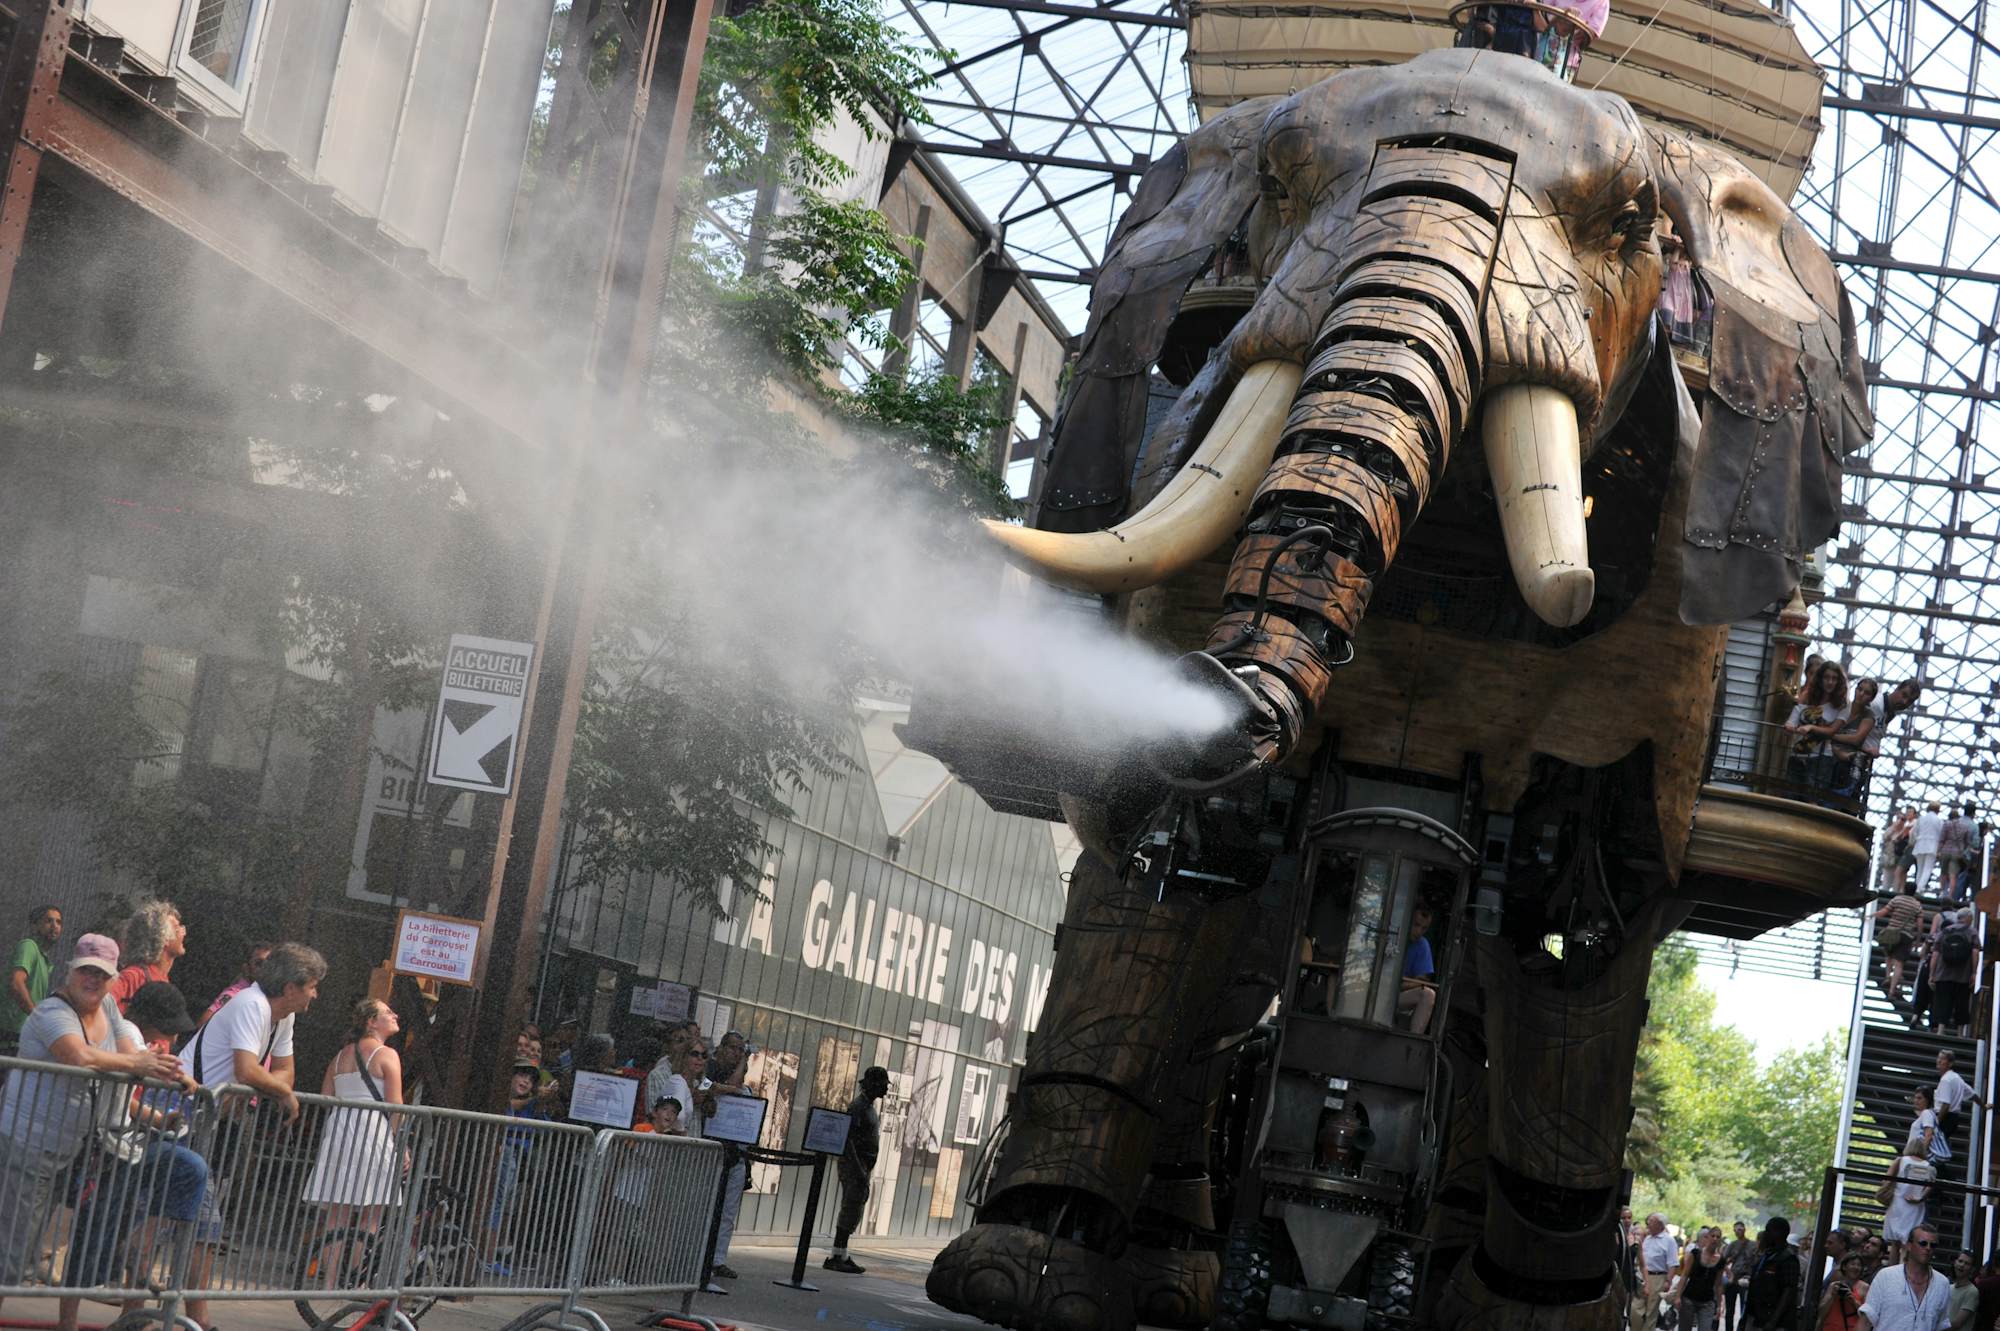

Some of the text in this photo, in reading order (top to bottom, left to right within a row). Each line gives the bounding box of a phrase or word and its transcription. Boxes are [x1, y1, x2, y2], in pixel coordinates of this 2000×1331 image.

[451, 650, 523, 675] ACCUEIL
[448, 672, 522, 695] BILLETTERIE
[409, 921, 470, 940] La billetterie
[406, 933, 468, 951] du Carrousel
[714, 862, 1053, 1033] LA GALERIE DES M
[421, 948, 450, 960] est au
[409, 956, 457, 972] Carrousel
